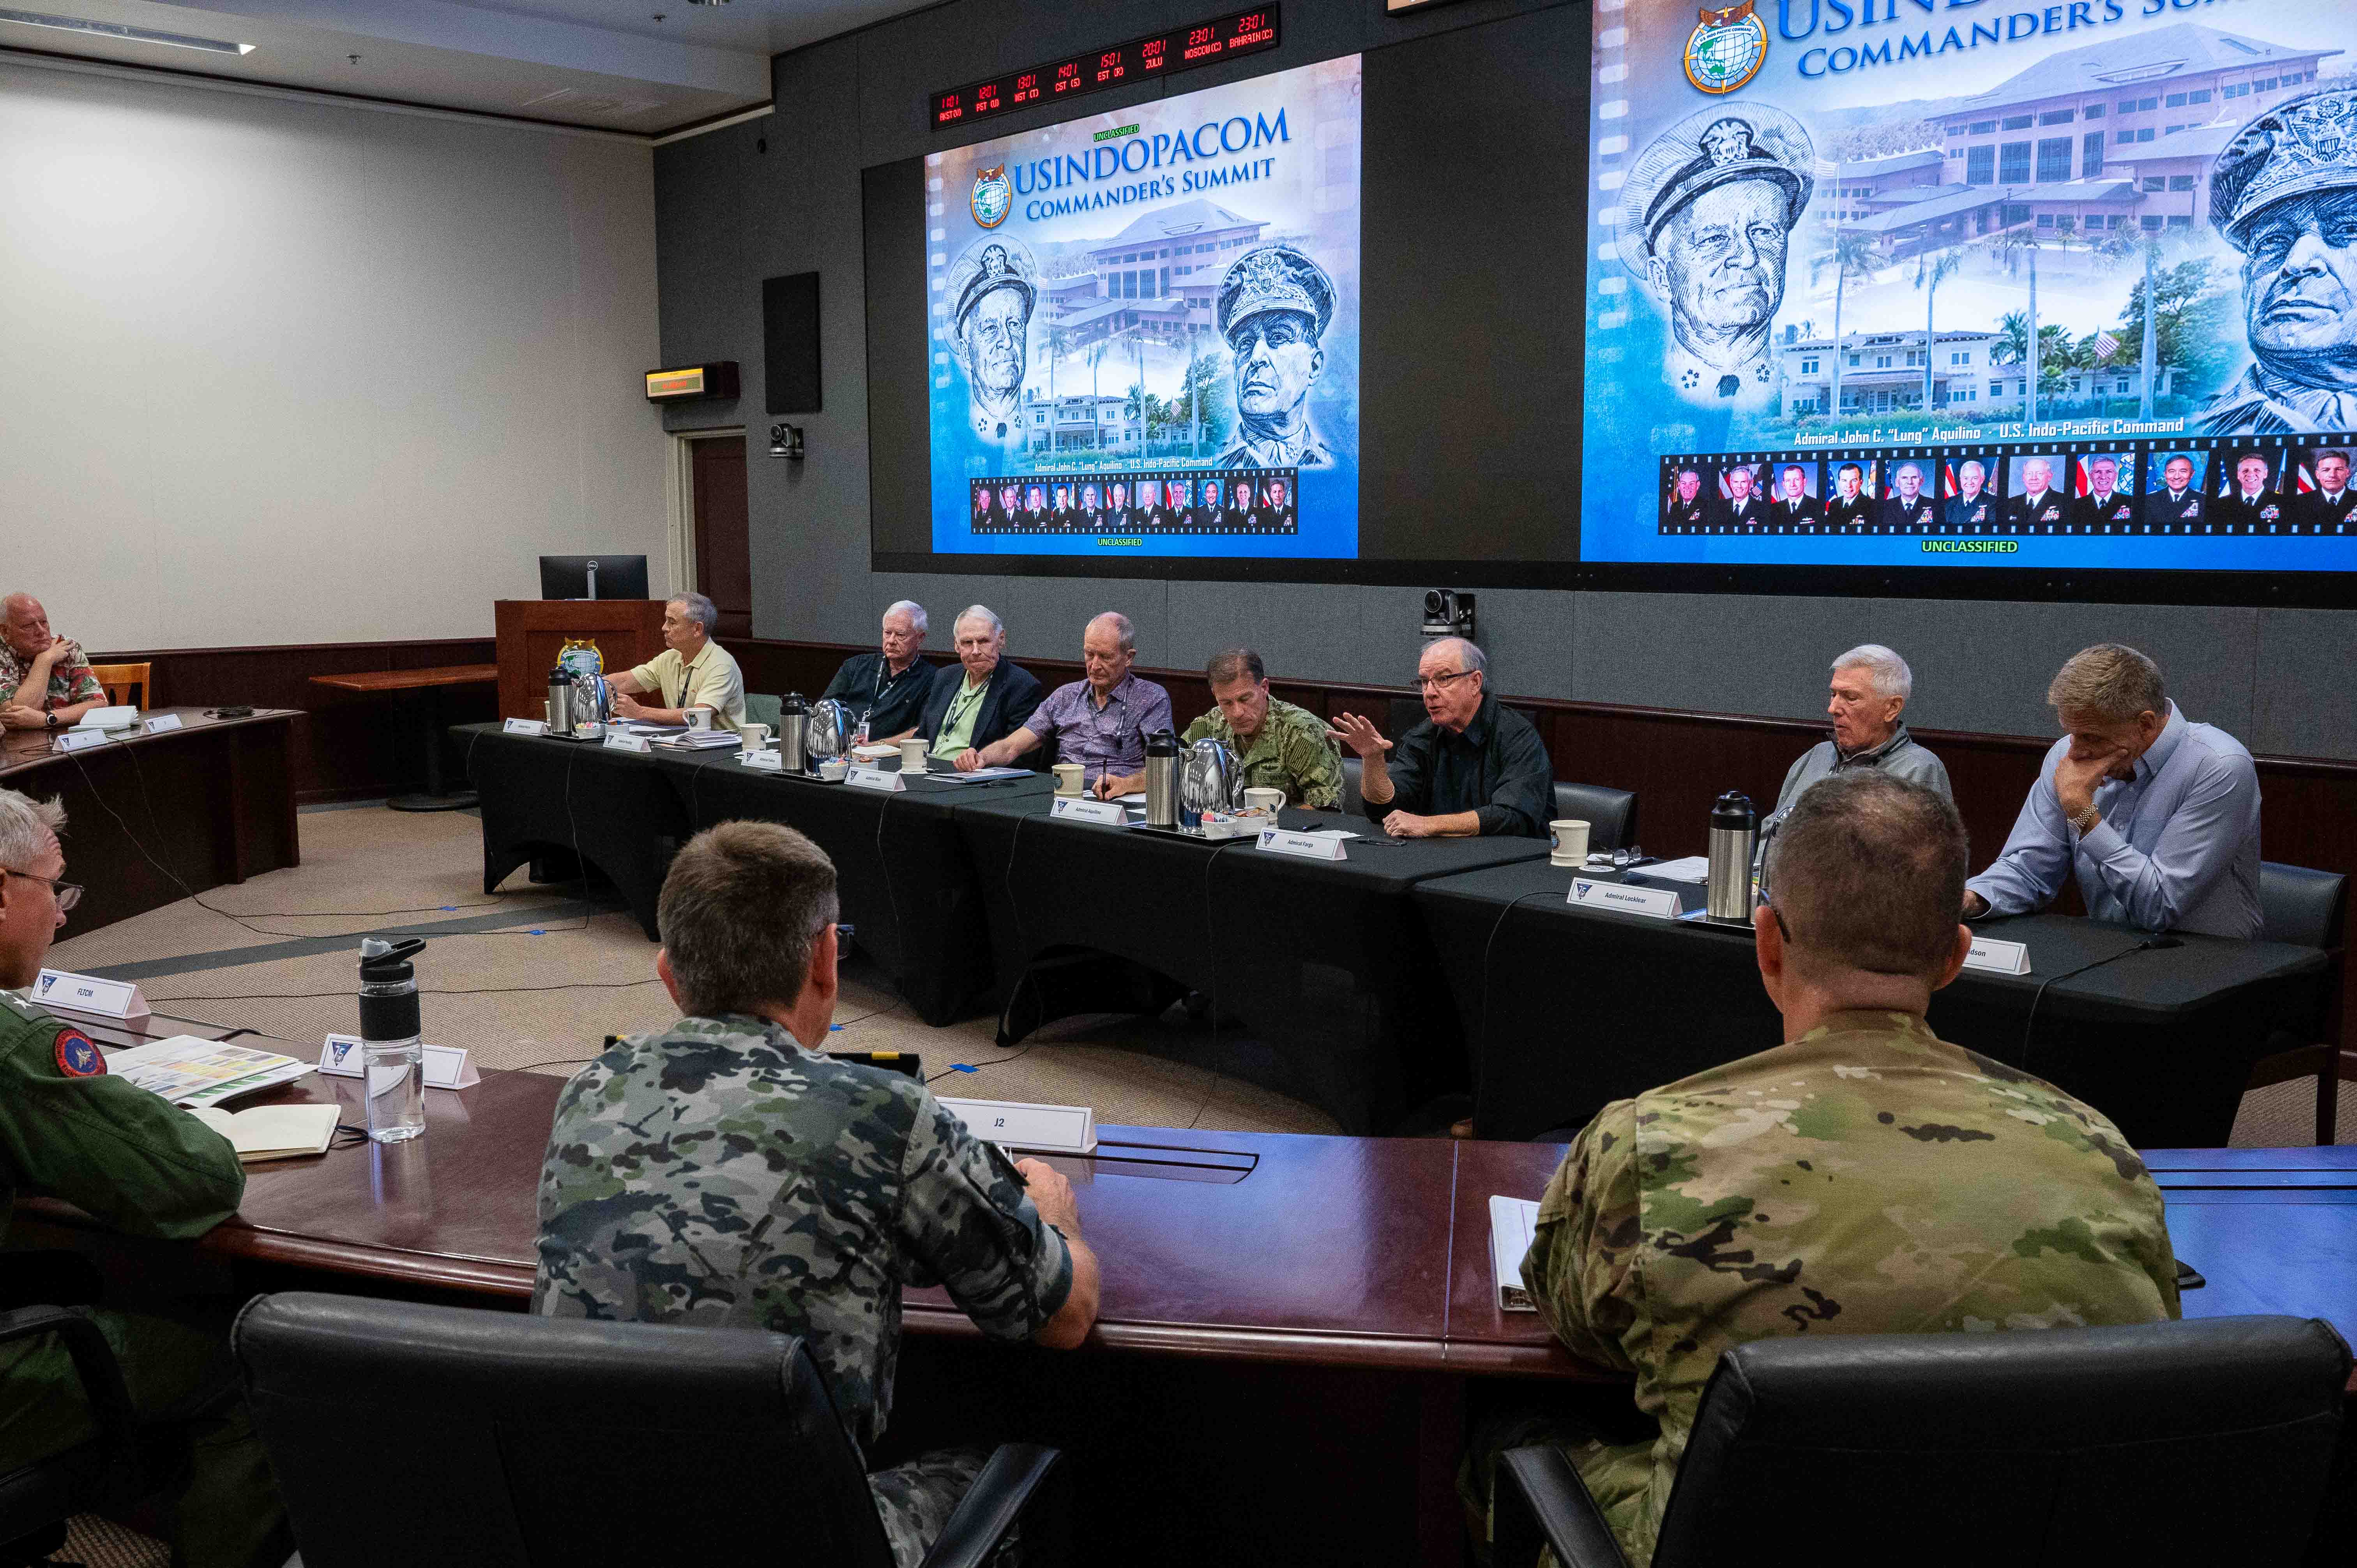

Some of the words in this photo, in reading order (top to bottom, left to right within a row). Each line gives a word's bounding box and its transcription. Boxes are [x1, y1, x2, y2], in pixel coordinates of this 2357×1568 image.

[1238, 13, 1265, 32] 23:01
[1189, 26, 1214, 45] 23:01
[1799, 0, 2123, 76] COMMANDERS
[1142, 40, 1166, 57] 20:01
[1101, 51, 1121, 68] 15:01
[1146, 56, 1163, 69] ZULU
[1058, 62, 1077, 78] 14:01
[1097, 70, 1110, 81] EST
[1017, 75, 1035, 89] 13:01
[1055, 81, 1066, 92] CST
[976, 102, 987, 112] PST
[1094, 124, 1139, 141] UNCLASSIFIED
[1014, 106, 1292, 194] USINDOPACOM
[1027, 174, 1175, 220] COMMANDER'S
[1183, 157, 1275, 192] SUMMIT
[1794, 431, 1838, 446] Admiral
[1841, 430, 1869, 444] John
[1873, 429, 1884, 443] C.
[1932, 426, 1981, 443] Aquilino
[2000, 424, 2025, 438] U.S.
[2029, 420, 2109, 437] Indo-Pacific
[2113, 417, 2184, 434] Command
[1035, 463, 1056, 472] Admiral
[1057, 463, 1071, 472] John
[1072, 463, 1078, 471] C.
[1099, 461, 1122, 471] Aquilino
[1130, 459, 1142, 469] U.S.
[1144, 457, 1180, 468] Indo-Pacific
[1181, 456, 1212, 467] Command
[1922, 541, 2018, 552] UNCLASSIFIED
[1625, 895, 1646, 903] Locklear
[1968, 948, 1986, 957] idson
[77, 988, 93, 997] FLTCM
[994, 1118, 1004, 1127] J2
